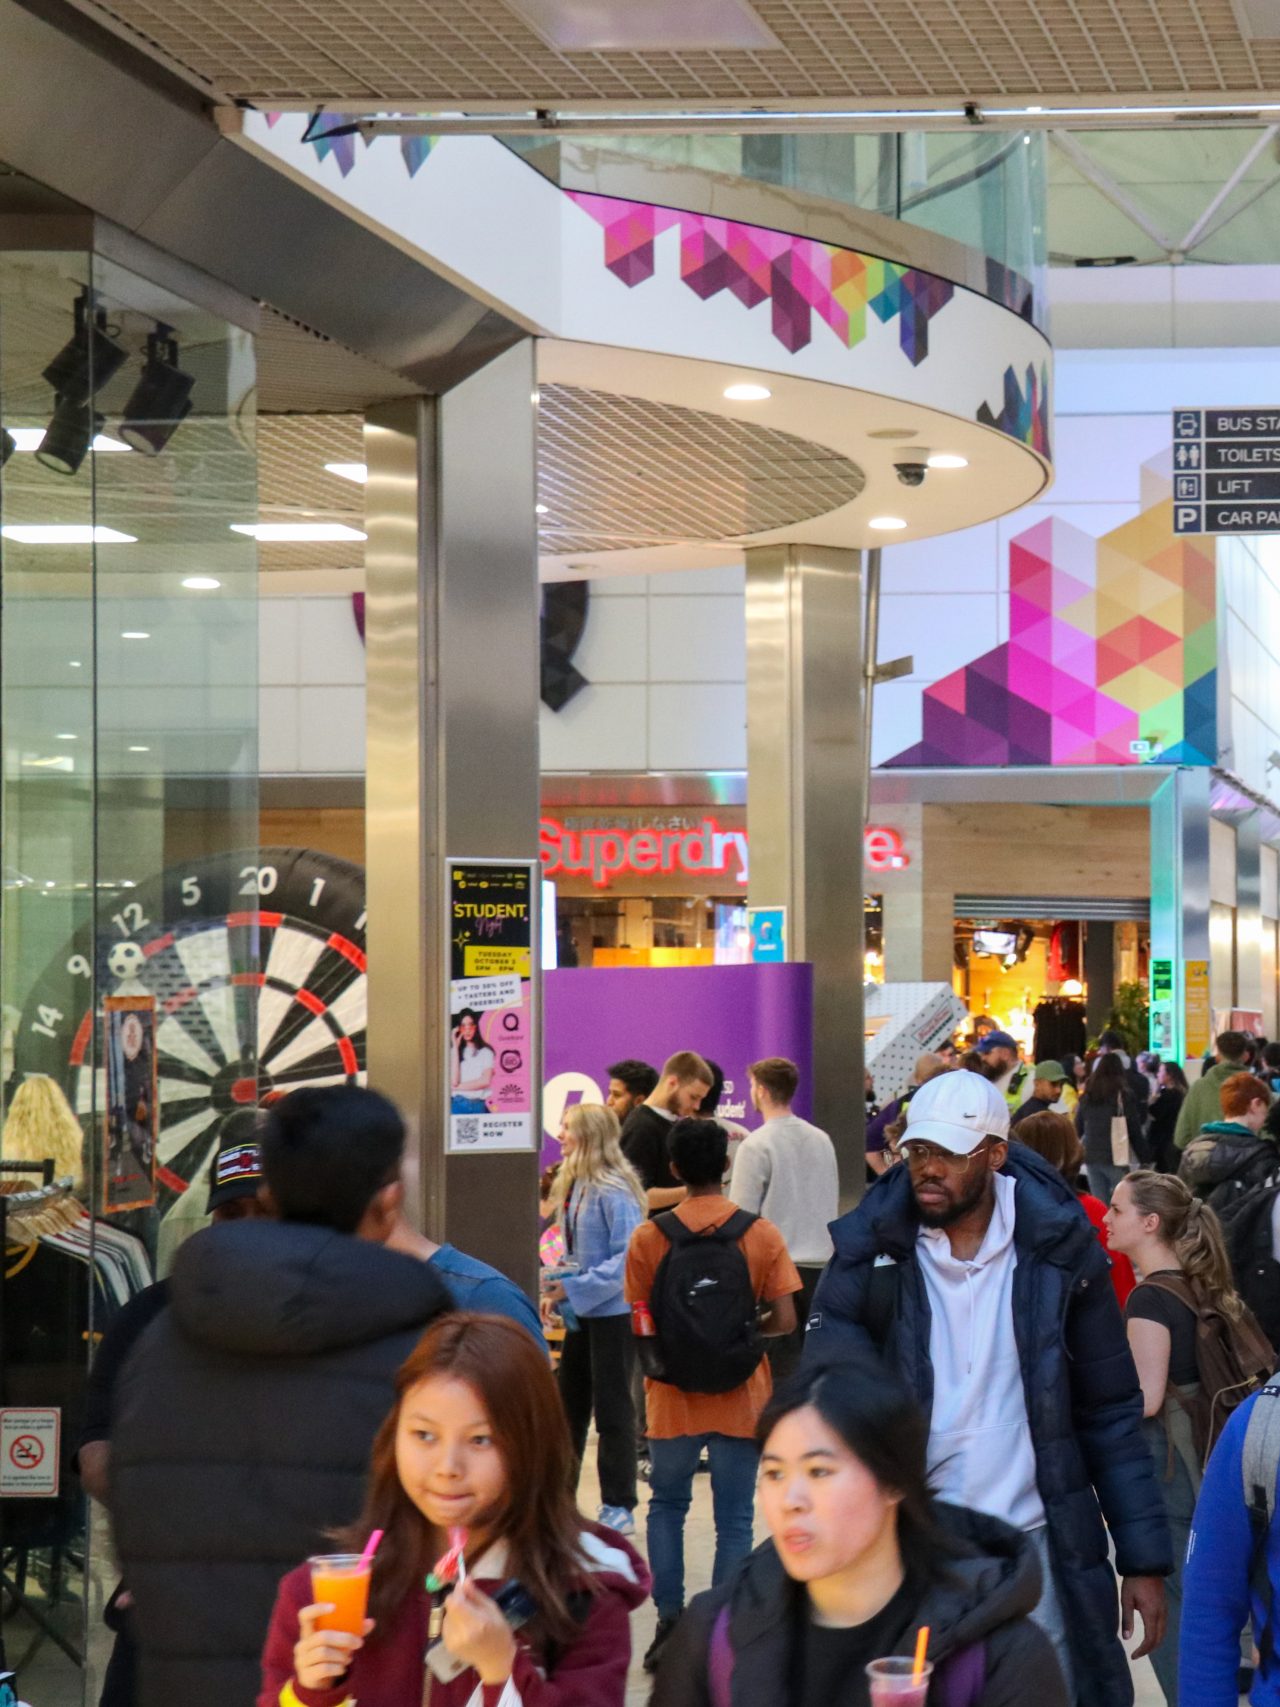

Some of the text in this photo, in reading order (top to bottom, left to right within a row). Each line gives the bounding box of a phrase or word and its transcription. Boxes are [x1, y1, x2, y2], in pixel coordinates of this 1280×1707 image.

[1217, 416, 1252, 431] BUS
[1217, 479, 1252, 494] LIFT
[1217, 511, 1253, 526] CAR
[181, 876, 201, 906] 5
[238, 866, 279, 897] 20
[309, 877, 325, 907] 1
[111, 902, 150, 938] 12
[454, 903, 527, 918] STUDENT
[66, 954, 91, 978] 9
[31, 1003, 64, 1039] 14
